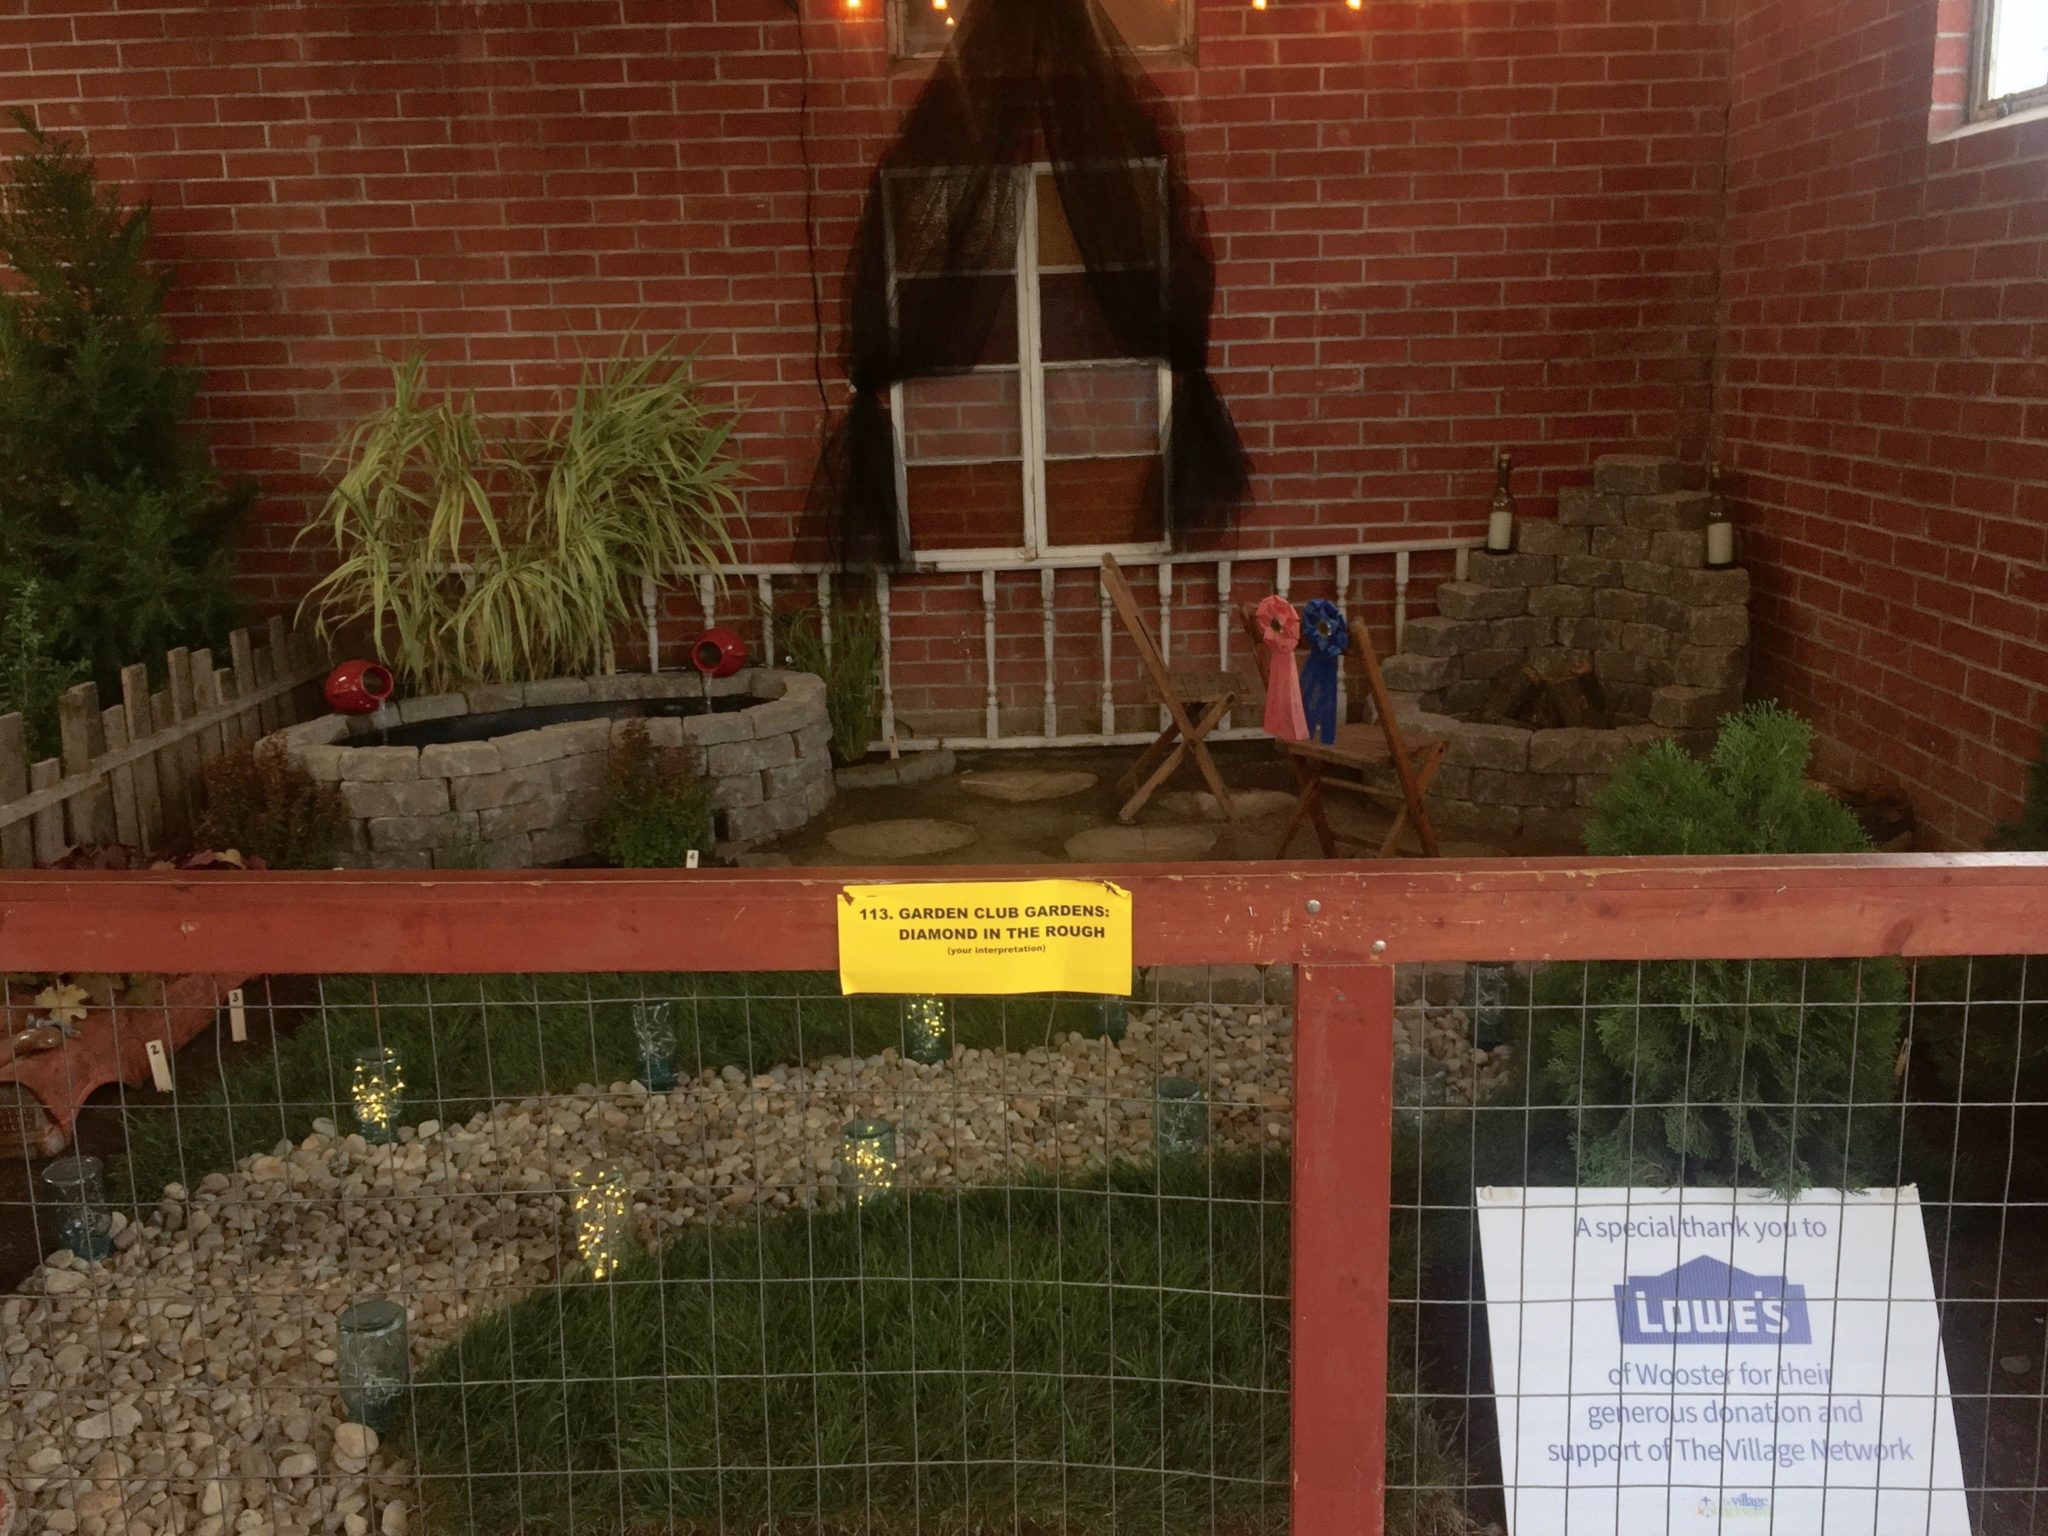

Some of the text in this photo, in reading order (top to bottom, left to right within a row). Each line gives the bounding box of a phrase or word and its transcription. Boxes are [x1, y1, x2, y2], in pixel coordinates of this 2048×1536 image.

[859, 905, 1110, 921] 113. GARDEN CLUB GARDENS:
[899, 925, 1105, 941] DIAMOND IN THE ROUGH
[947, 944, 1046, 956] (your interpretation)
[232, 992, 239, 1002] 3
[150, 1044, 160, 1055] 2
[1576, 1215, 1828, 1243] A special thank you to
[1635, 1290, 1790, 1335] LOWE'S
[1608, 1361, 1832, 1386] of Wooster for their
[1588, 1405, 1698, 1431] generous
[1818, 1399, 1864, 1423] and
[1548, 1436, 1914, 1469] support of The Village Network
[1731, 1492, 1768, 1510] village
